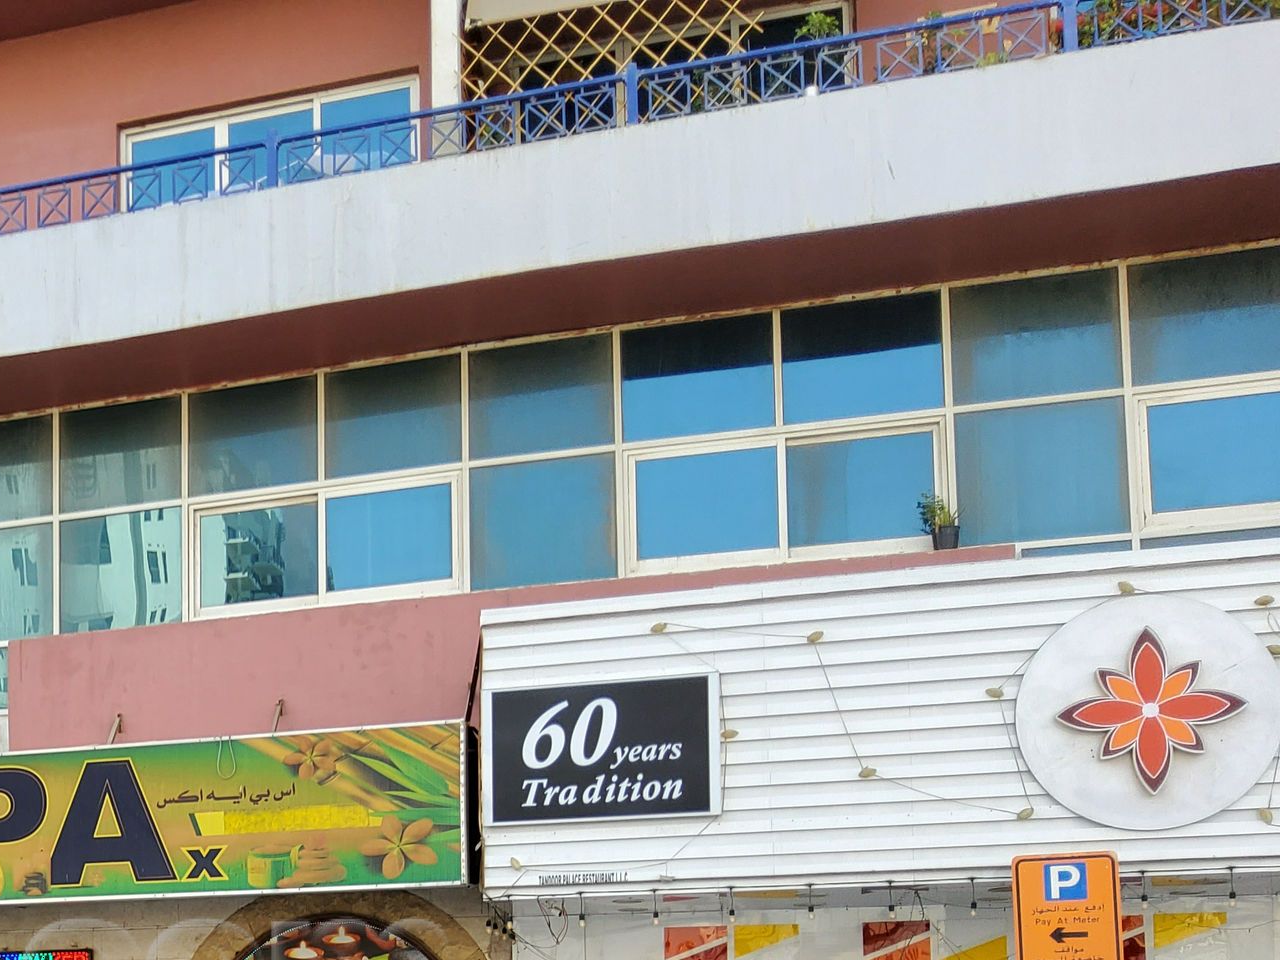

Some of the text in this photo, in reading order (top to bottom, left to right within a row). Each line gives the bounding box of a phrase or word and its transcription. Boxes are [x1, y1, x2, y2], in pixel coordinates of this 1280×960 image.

[522, 697, 682, 770] 60 years
[521, 772, 683, 808] Tradition
[1049, 865, 1081, 899] P
[1035, 916, 1100, 927] Pay At Meter
